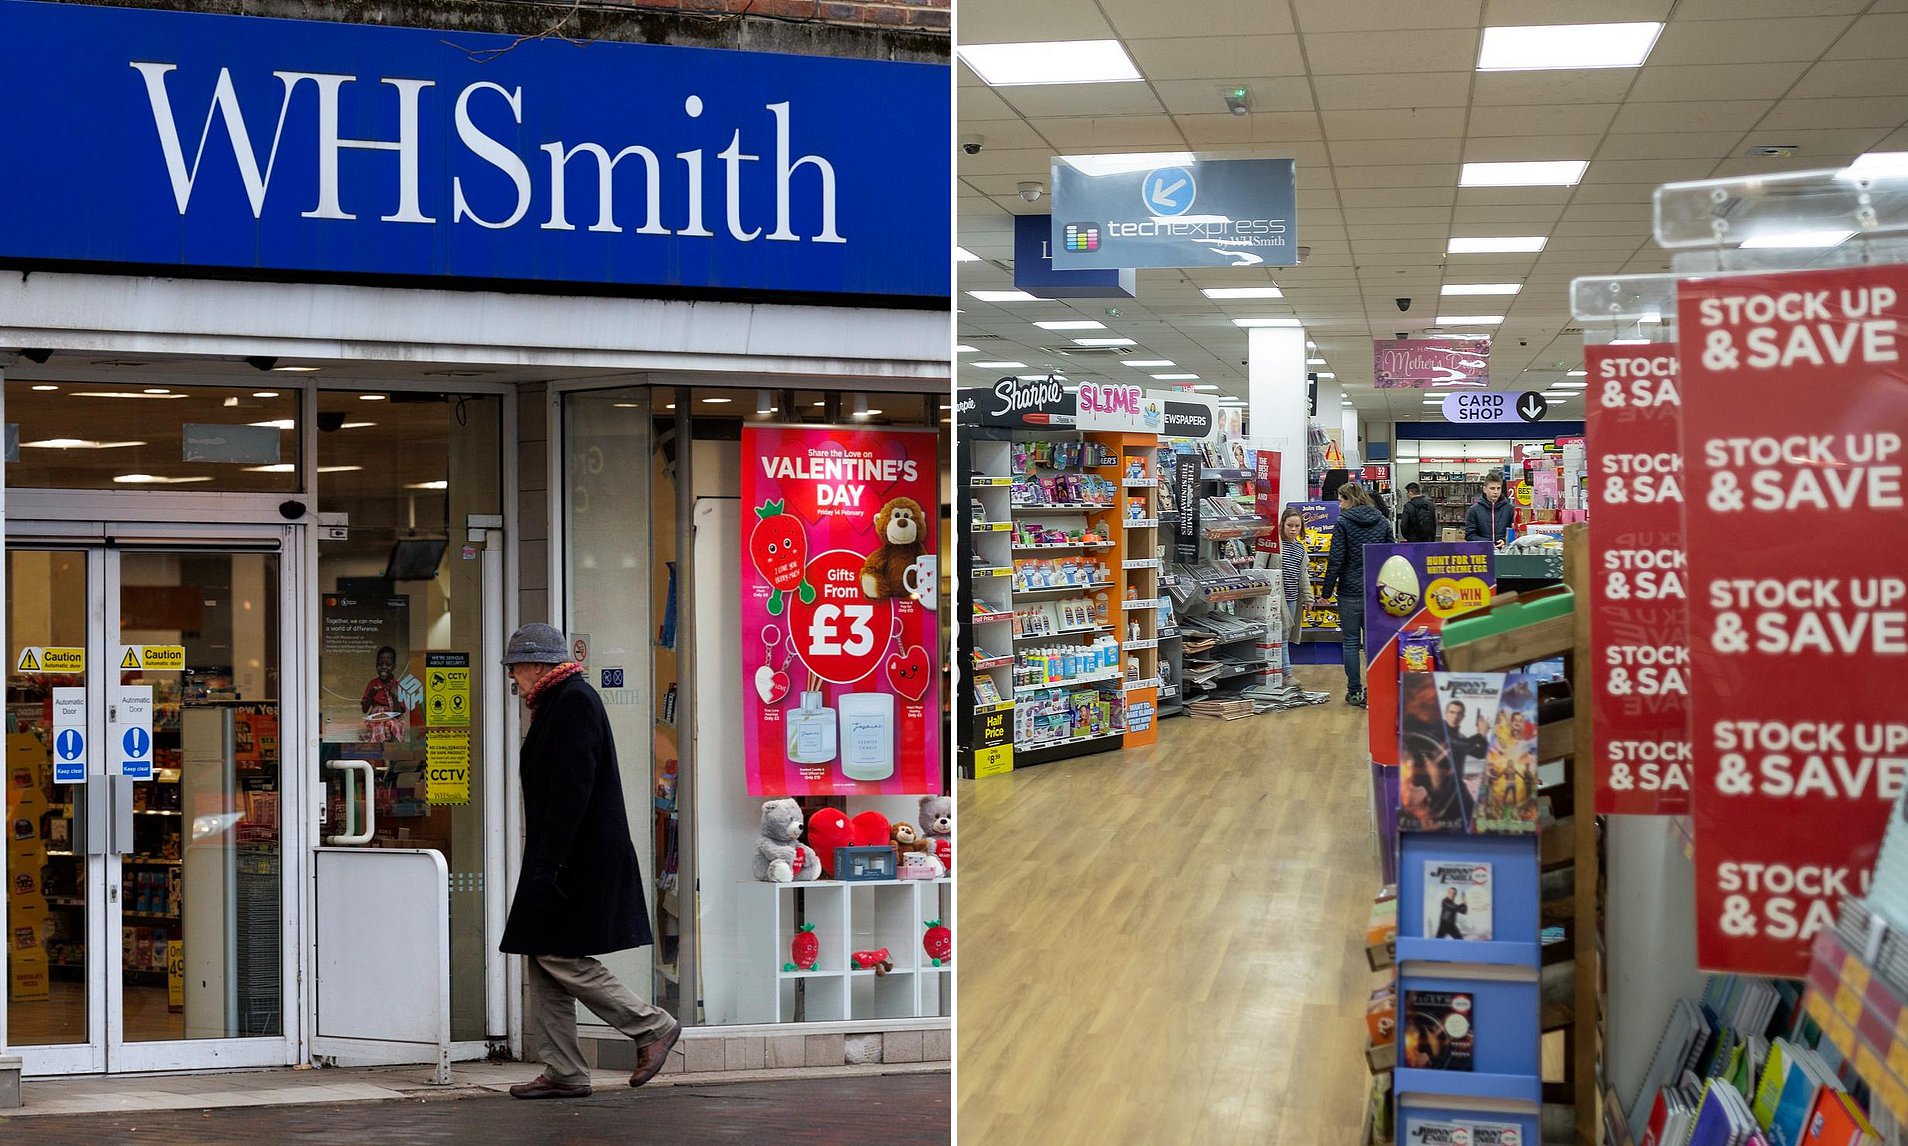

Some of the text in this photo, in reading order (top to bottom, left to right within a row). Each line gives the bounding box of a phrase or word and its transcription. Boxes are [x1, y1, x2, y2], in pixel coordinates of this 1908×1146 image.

[130, 60, 847, 243] WHSmith
[1700, 287, 1897, 327] STOCK UP
[1702, 320, 1899, 371] & SAVE
[1384, 350, 1443, 377] Mother's
[991, 377, 1063, 416] Sharpie
[1080, 385, 1141, 414] SLIME
[1458, 395, 1504, 407] CARD
[1601, 380, 1626, 408] &
[1459, 408, 1504, 420] SHOP
[808, 449, 829, 457] Share
[830, 449, 842, 457] the
[844, 449, 861, 458] Love
[1704, 433, 1901, 467] STOCK UP
[761, 456, 918, 482] VALENTINE'S
[816, 484, 865, 507] DAY
[1603, 477, 1628, 504] &
[1707, 466, 1903, 512] & SAVE
[1426, 554, 1488, 566] HUNT FOR THE
[1446, 565, 1472, 573] CREME
[1473, 564, 1488, 573] EGG
[827, 568, 855, 581] Gifts
[1605, 571, 1631, 600] &
[824, 584, 858, 598] From
[1460, 588, 1482, 600] WIN
[1709, 579, 1906, 609] STOCK UP
[808, 603, 874, 657] £3
[1711, 612, 1908, 655] & SAVE
[44, 651, 81, 662] Caution
[145, 649, 182, 660] Caution
[448, 672, 468, 680] CCTV
[1607, 667, 1633, 695] &
[62, 707, 77, 715] Door
[122, 696, 151, 704] Automatic
[984, 727, 1005, 739] Price
[986, 714, 1003, 727] Half
[1713, 721, 1908, 753] STOCK UP
[430, 769, 465, 781] CCTV
[1609, 763, 1634, 791] &
[1715, 753, 1755, 795] &
[1717, 862, 1848, 897] STOCK
[1719, 895, 1757, 938] &
